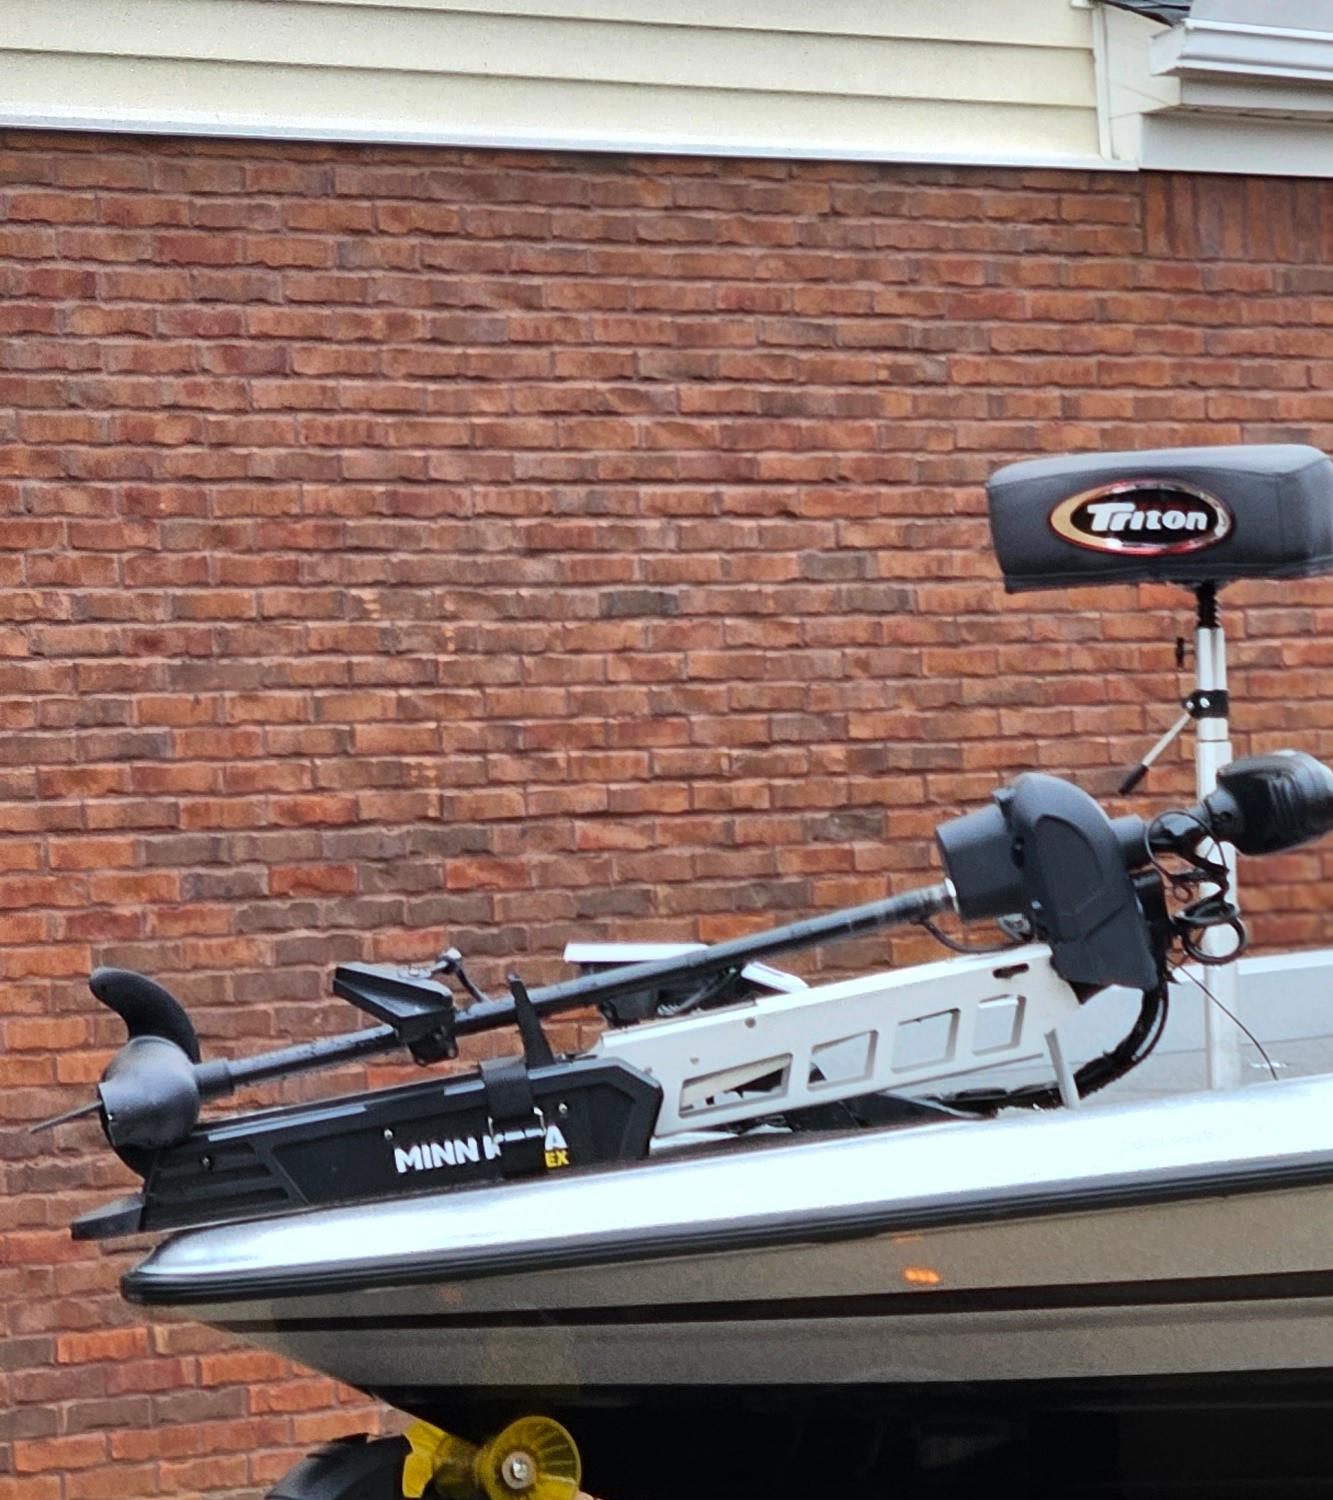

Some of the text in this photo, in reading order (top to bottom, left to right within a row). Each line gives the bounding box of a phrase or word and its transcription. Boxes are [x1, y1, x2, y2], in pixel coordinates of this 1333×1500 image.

[1086, 502, 1208, 532] Triton
[394, 1124, 568, 1174] MINN KA
